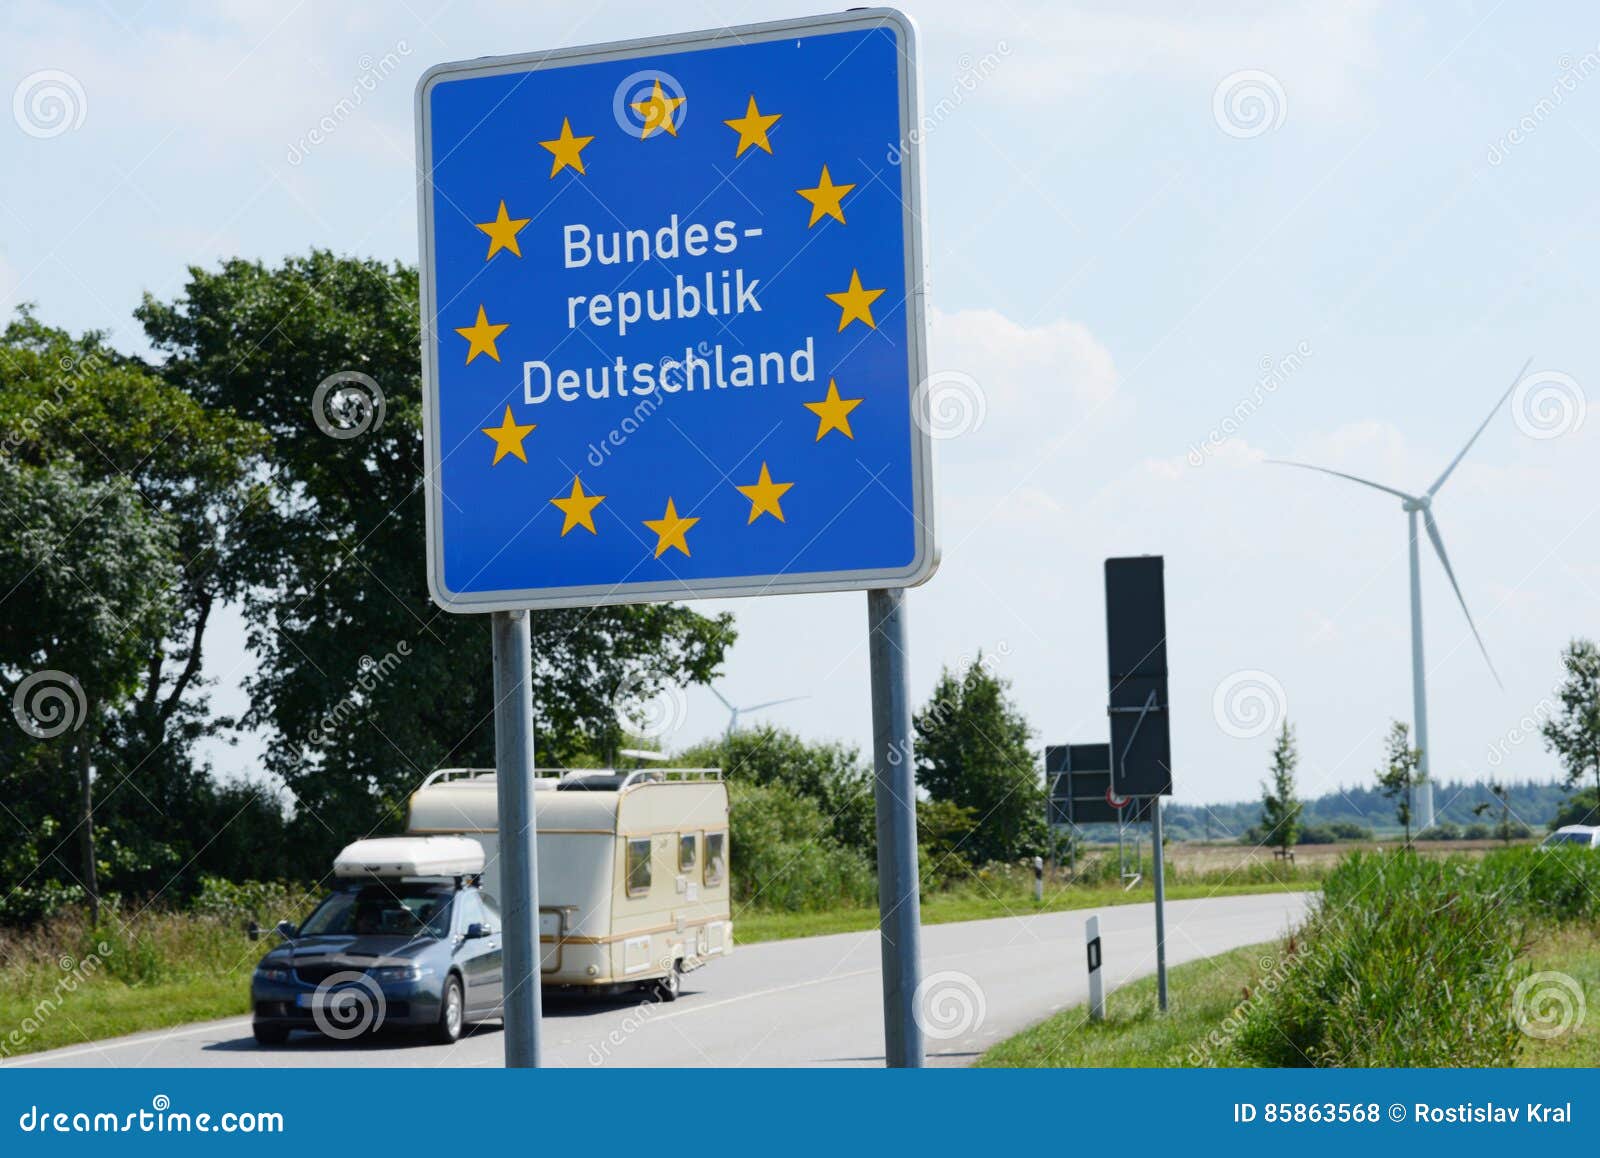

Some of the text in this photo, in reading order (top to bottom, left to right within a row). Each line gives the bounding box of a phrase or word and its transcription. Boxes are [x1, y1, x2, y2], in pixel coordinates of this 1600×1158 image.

[563, 214, 763, 269] Bundes-
[567, 269, 763, 336] republik
[523, 337, 815, 405] Deutschland
